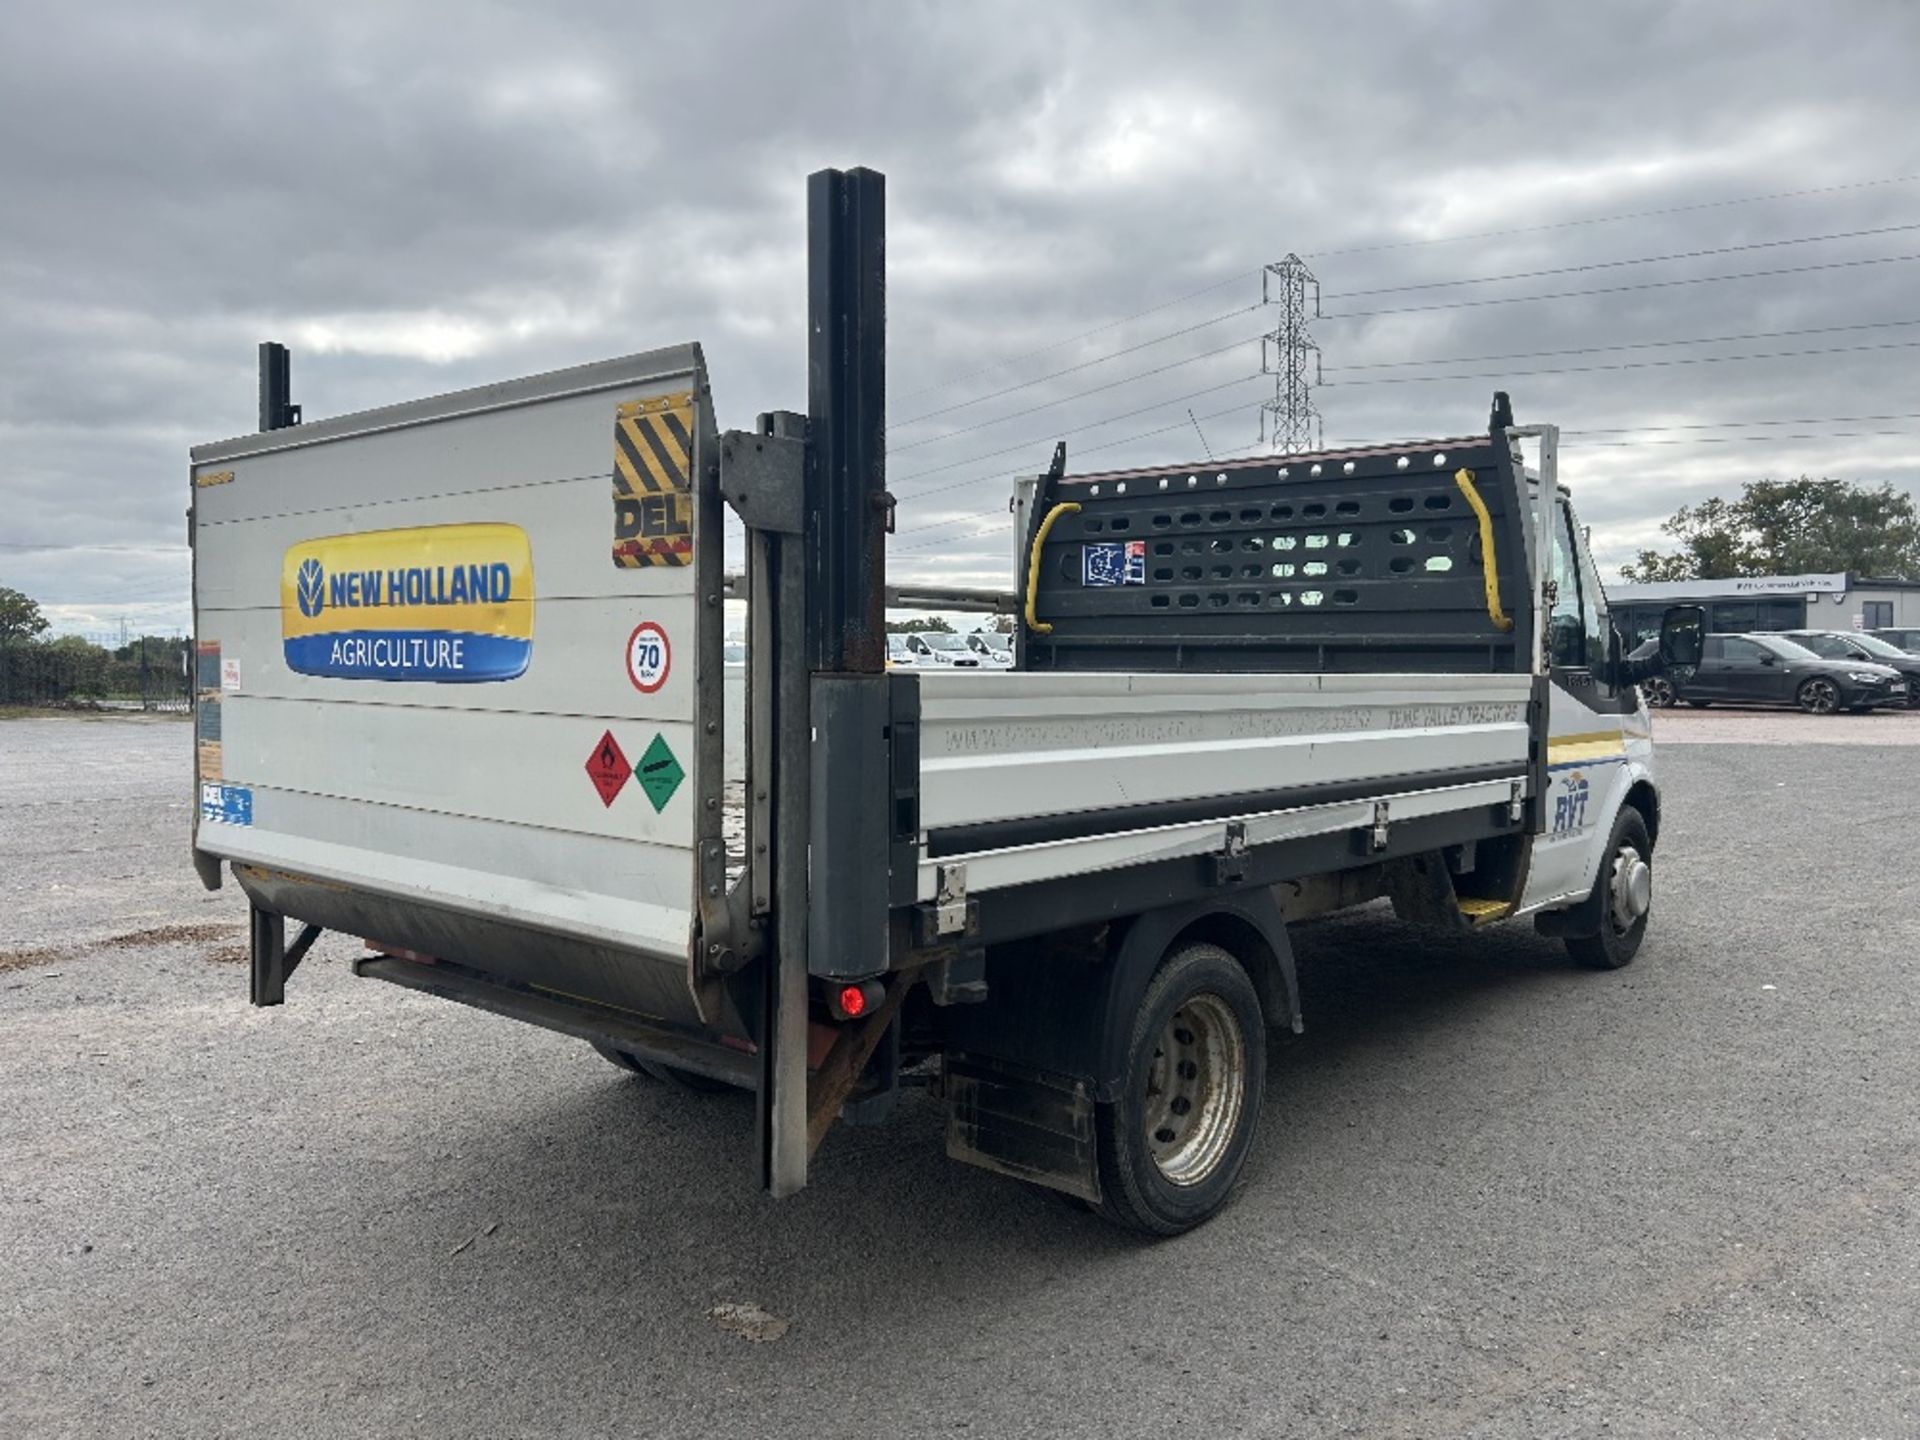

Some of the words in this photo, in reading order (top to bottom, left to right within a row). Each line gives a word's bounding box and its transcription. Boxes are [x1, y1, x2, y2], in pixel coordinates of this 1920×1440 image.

[615, 494, 689, 540] DEL
[330, 570, 383, 608] NEW
[388, 562, 511, 607] HOLLAND
[330, 639, 464, 669] AGRICULTURE
[638, 644, 660, 669] 70
